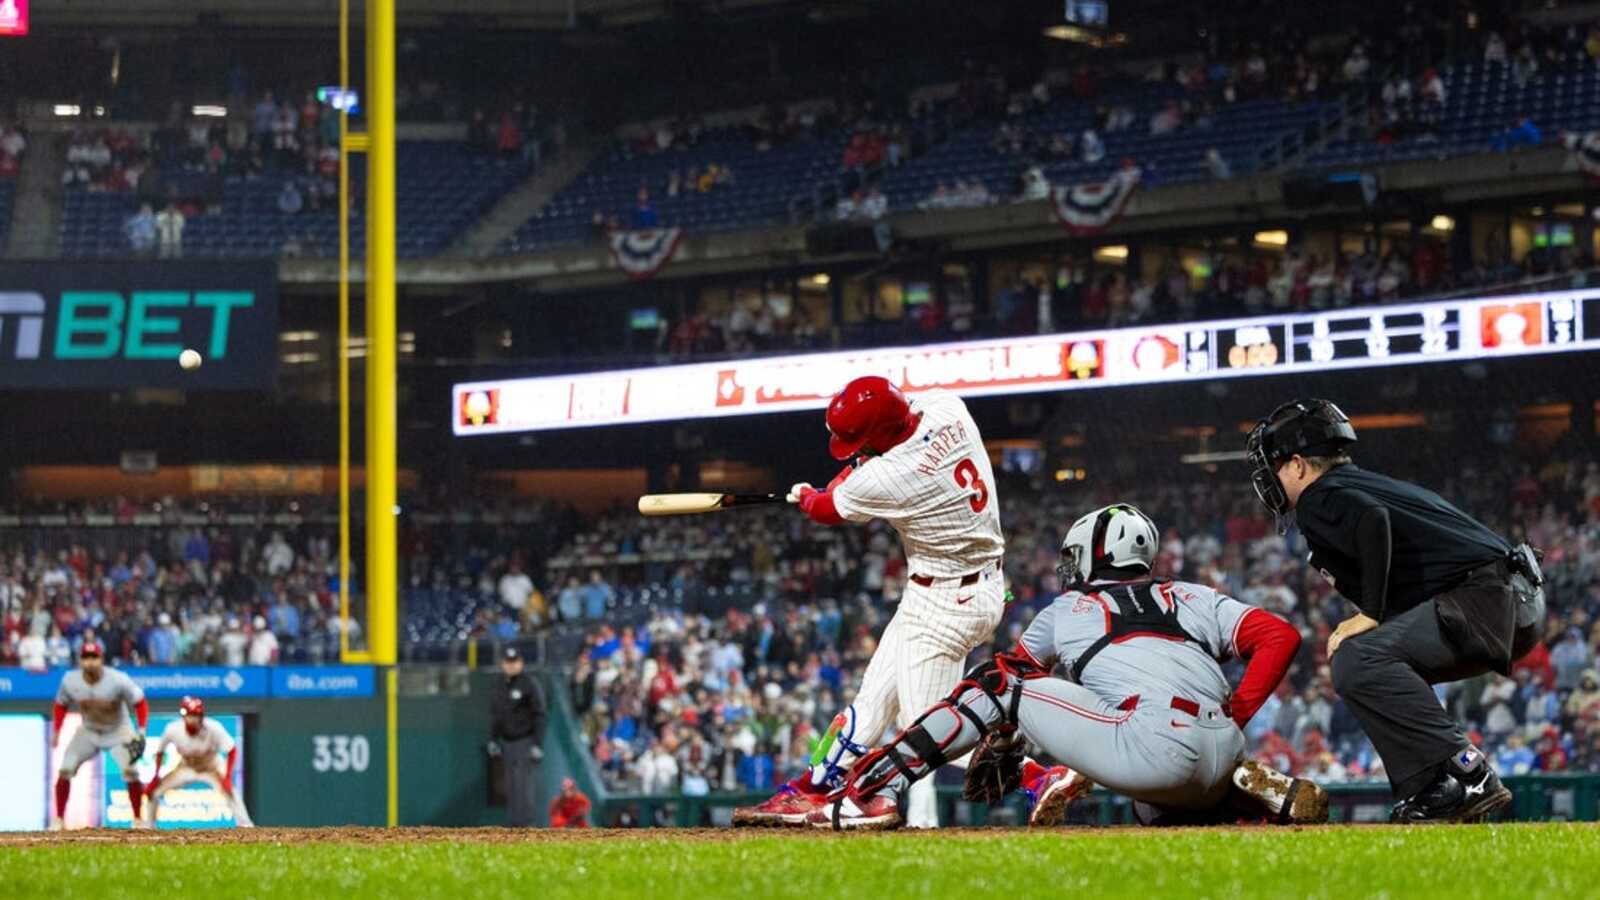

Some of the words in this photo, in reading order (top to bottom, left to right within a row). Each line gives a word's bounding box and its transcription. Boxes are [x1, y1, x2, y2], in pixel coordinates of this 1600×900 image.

[53, 290, 256, 359] BET
[916, 420, 967, 477] HARPER
[953, 457, 989, 514] 3
[313, 735, 370, 772] 330
